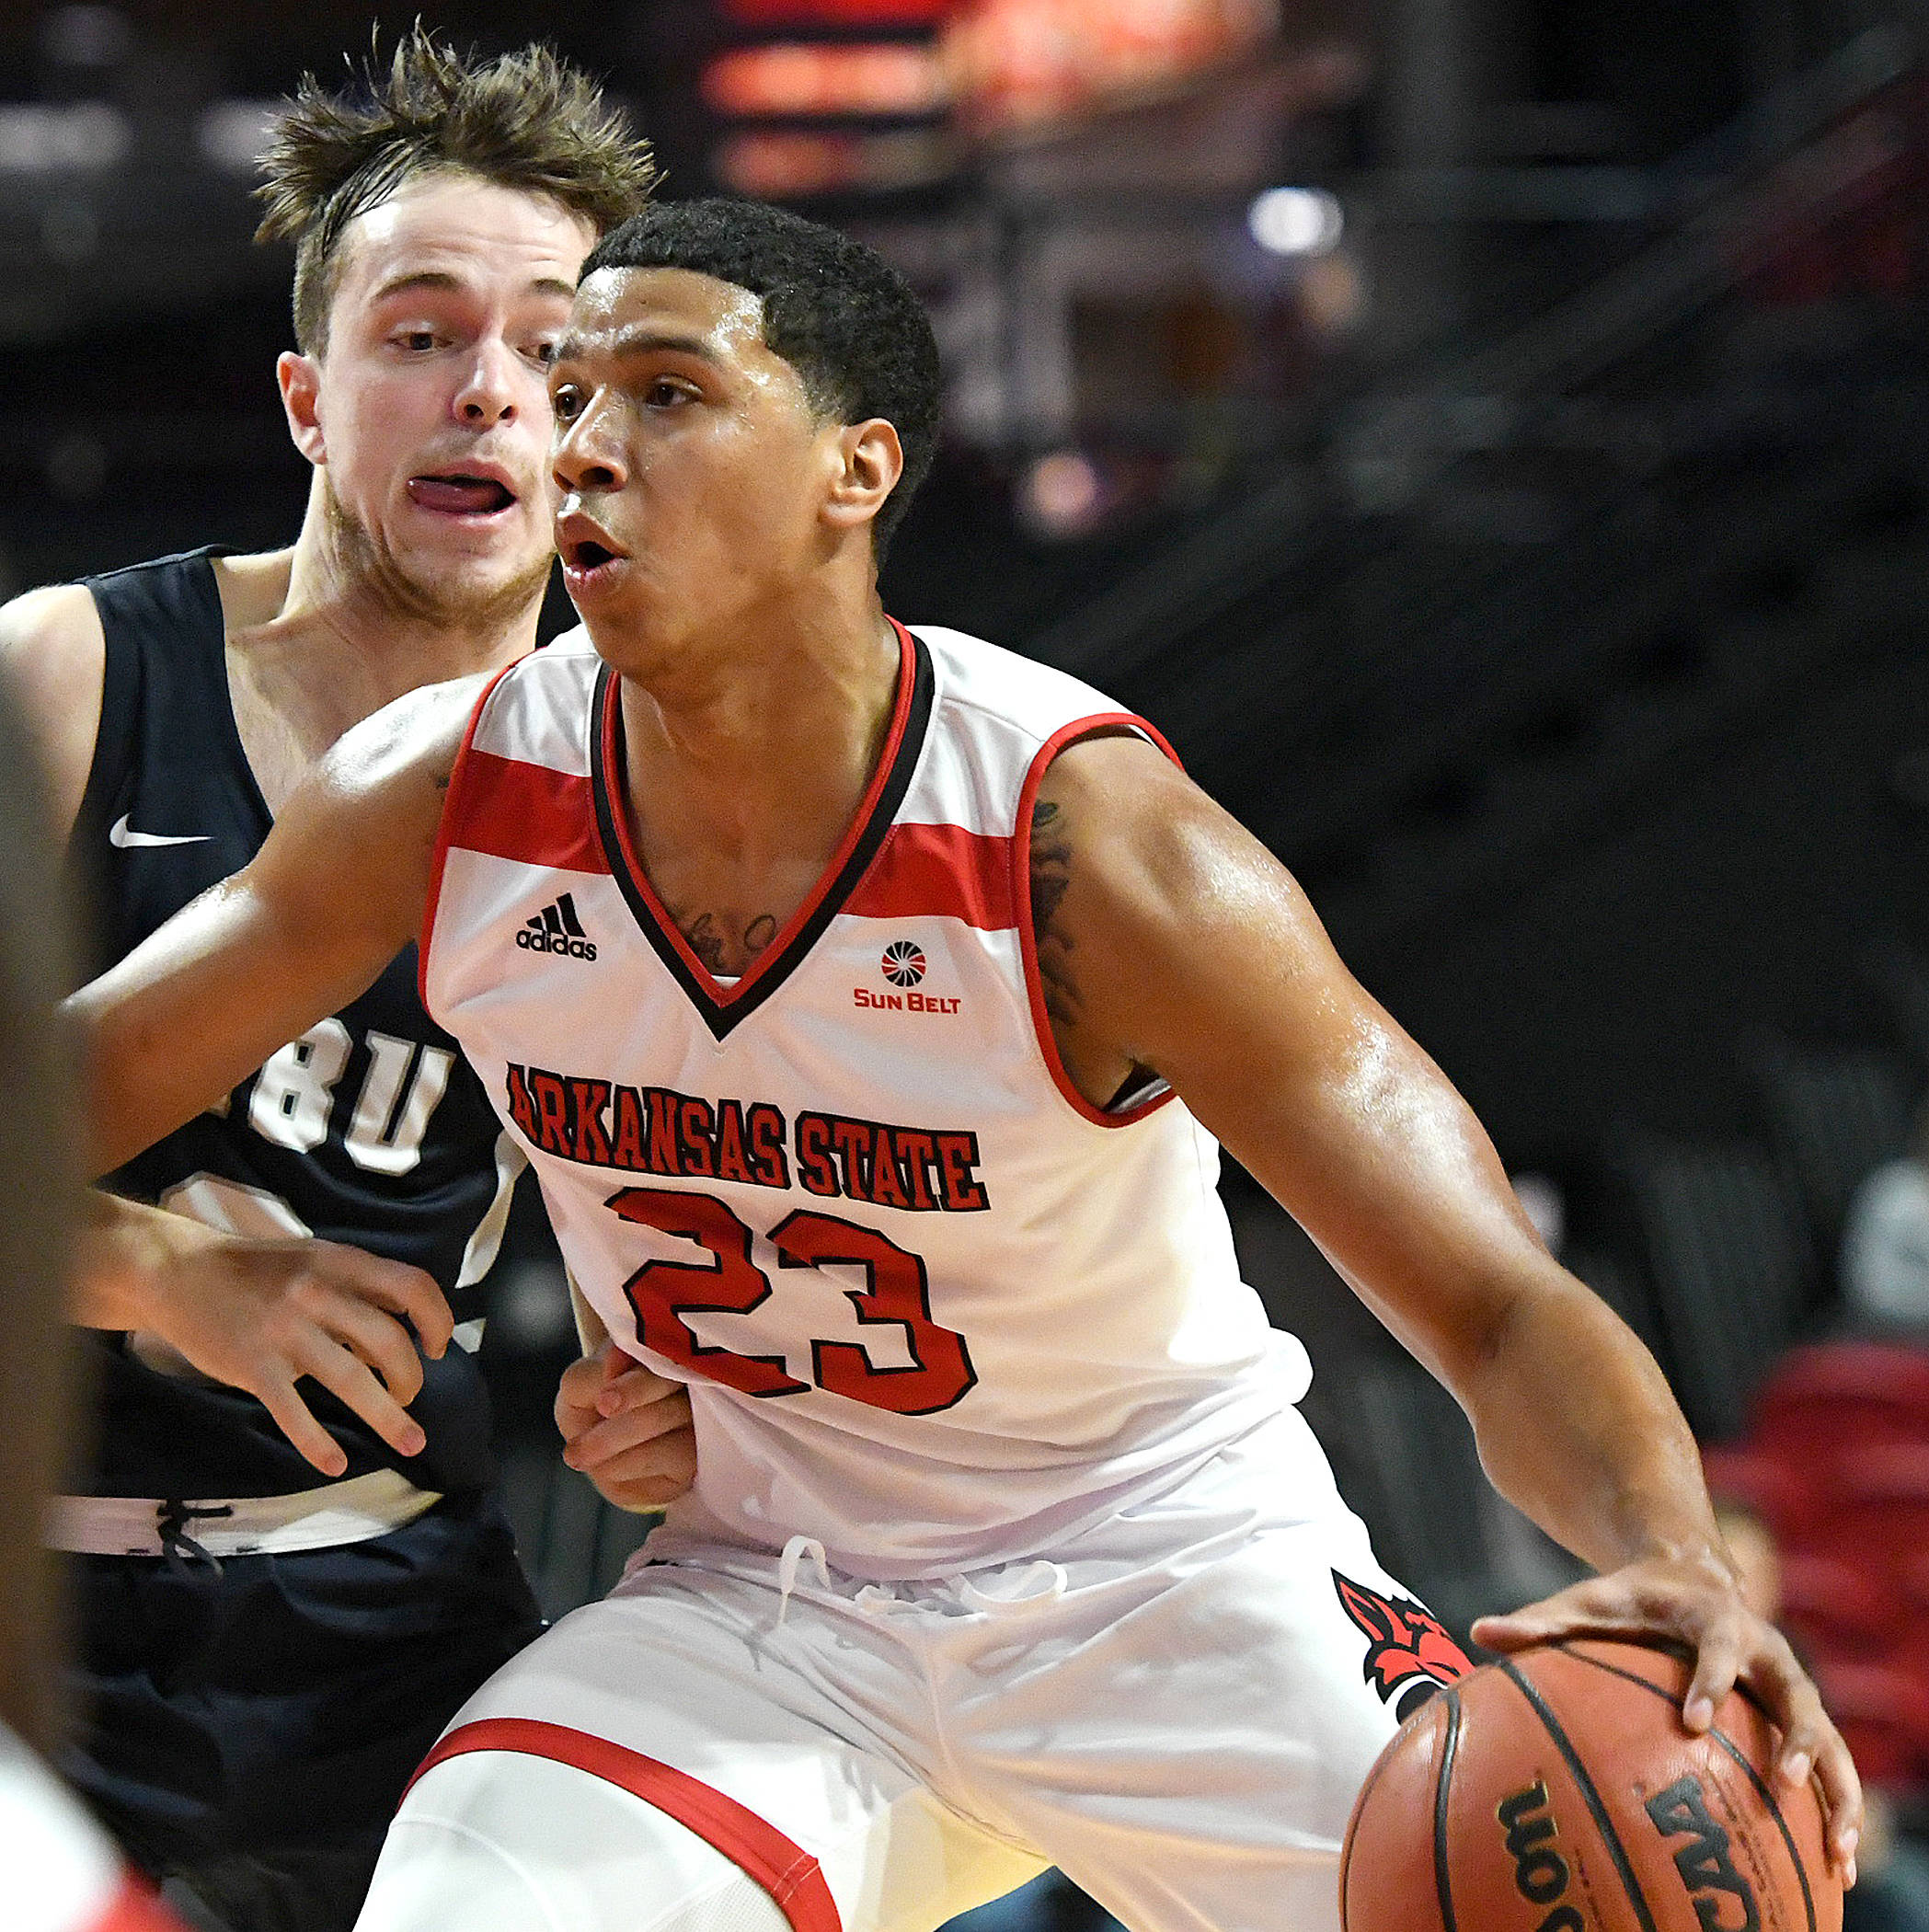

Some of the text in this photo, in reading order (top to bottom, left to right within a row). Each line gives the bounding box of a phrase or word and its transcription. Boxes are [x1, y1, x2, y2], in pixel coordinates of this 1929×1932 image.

[516, 929, 597, 962] adidas
[204, 1017, 458, 1178] BU
[507, 1062, 991, 1213] ARKANSAS STATE
[603, 1186, 979, 1417] 23
